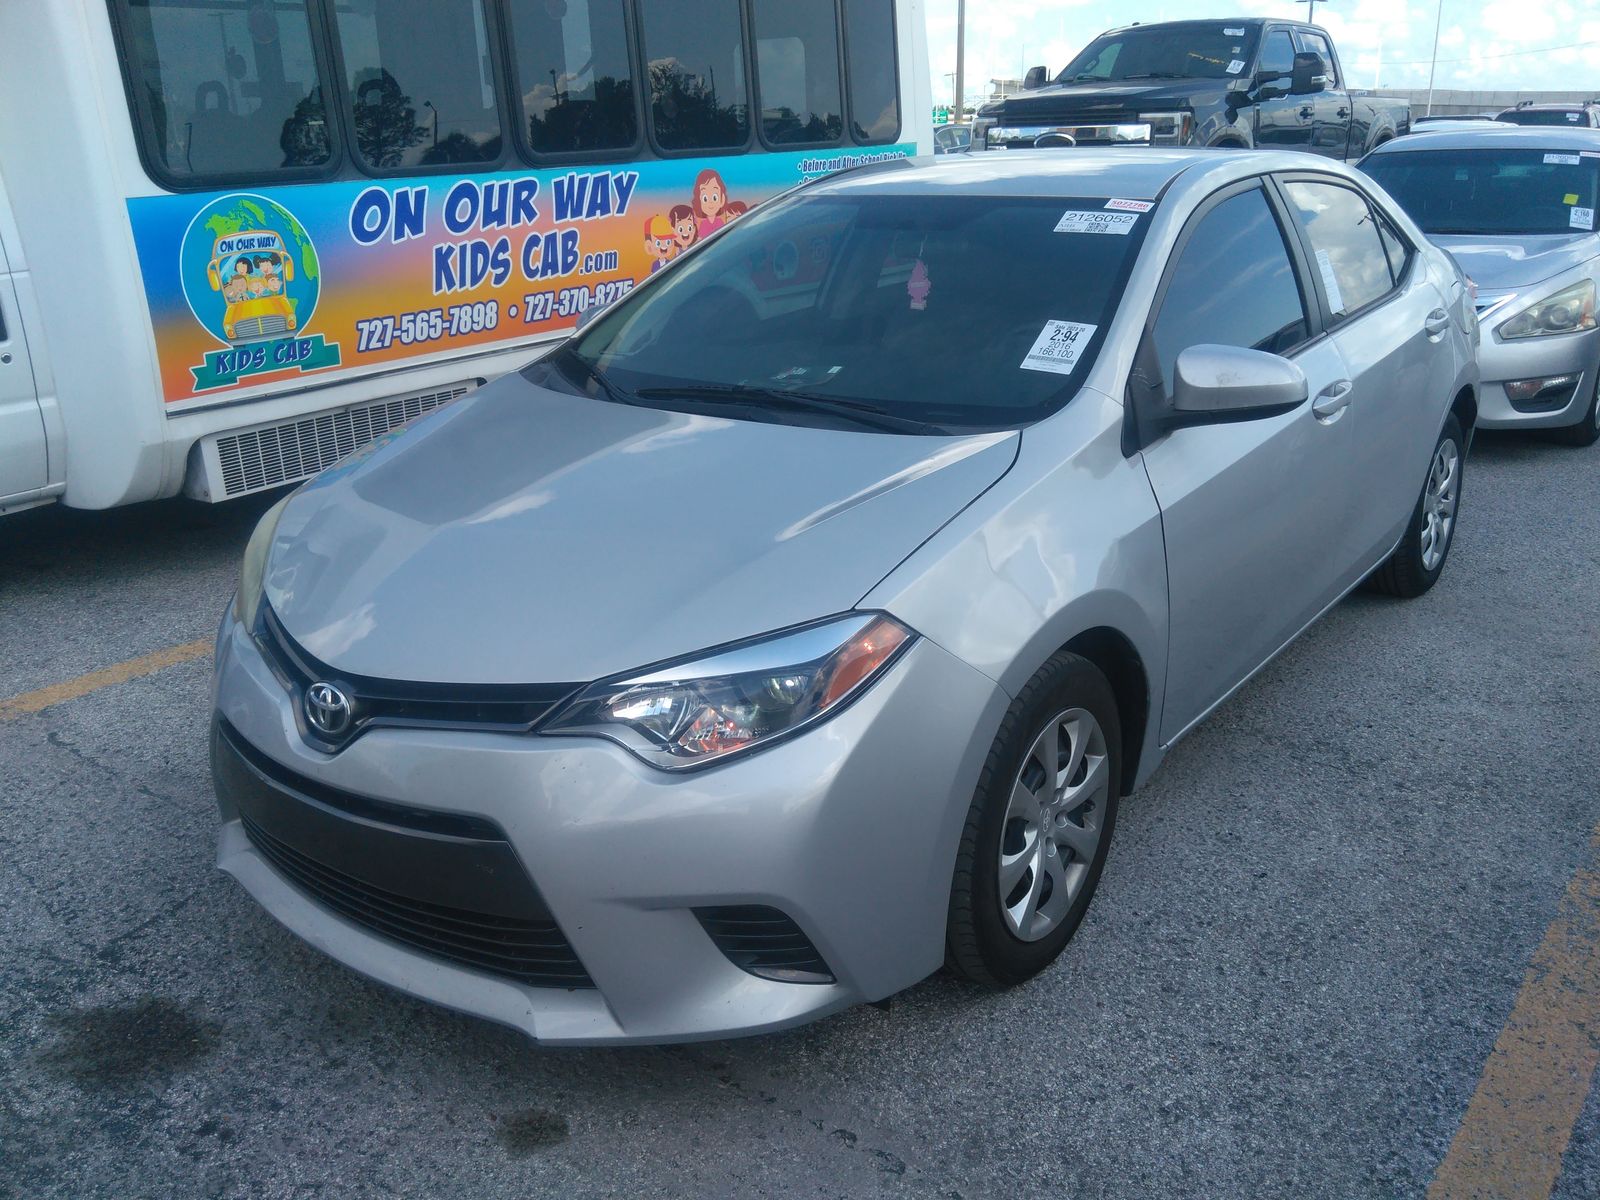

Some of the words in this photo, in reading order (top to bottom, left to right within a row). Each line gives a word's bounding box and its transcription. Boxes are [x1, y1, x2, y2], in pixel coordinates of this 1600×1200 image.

[803, 160, 827, 173] Before
[828, 159, 841, 171] and
[349, 186, 429, 246] ON
[443, 177, 540, 236] OUR
[552, 170, 639, 224] WAY
[1065, 212, 1134, 224] 2126052
[220, 239, 234, 252] ON
[236, 237, 256, 250] OUR
[257, 236, 276, 249] WAY
[433, 235, 512, 296] KIDS
[356, 299, 499, 353] 727-565-7898
[1049, 329, 1080, 344] 2:94
[1048, 341, 1072, 350] 2016
[216, 347, 266, 375] KIDS
[273, 340, 313, 364] CAB
